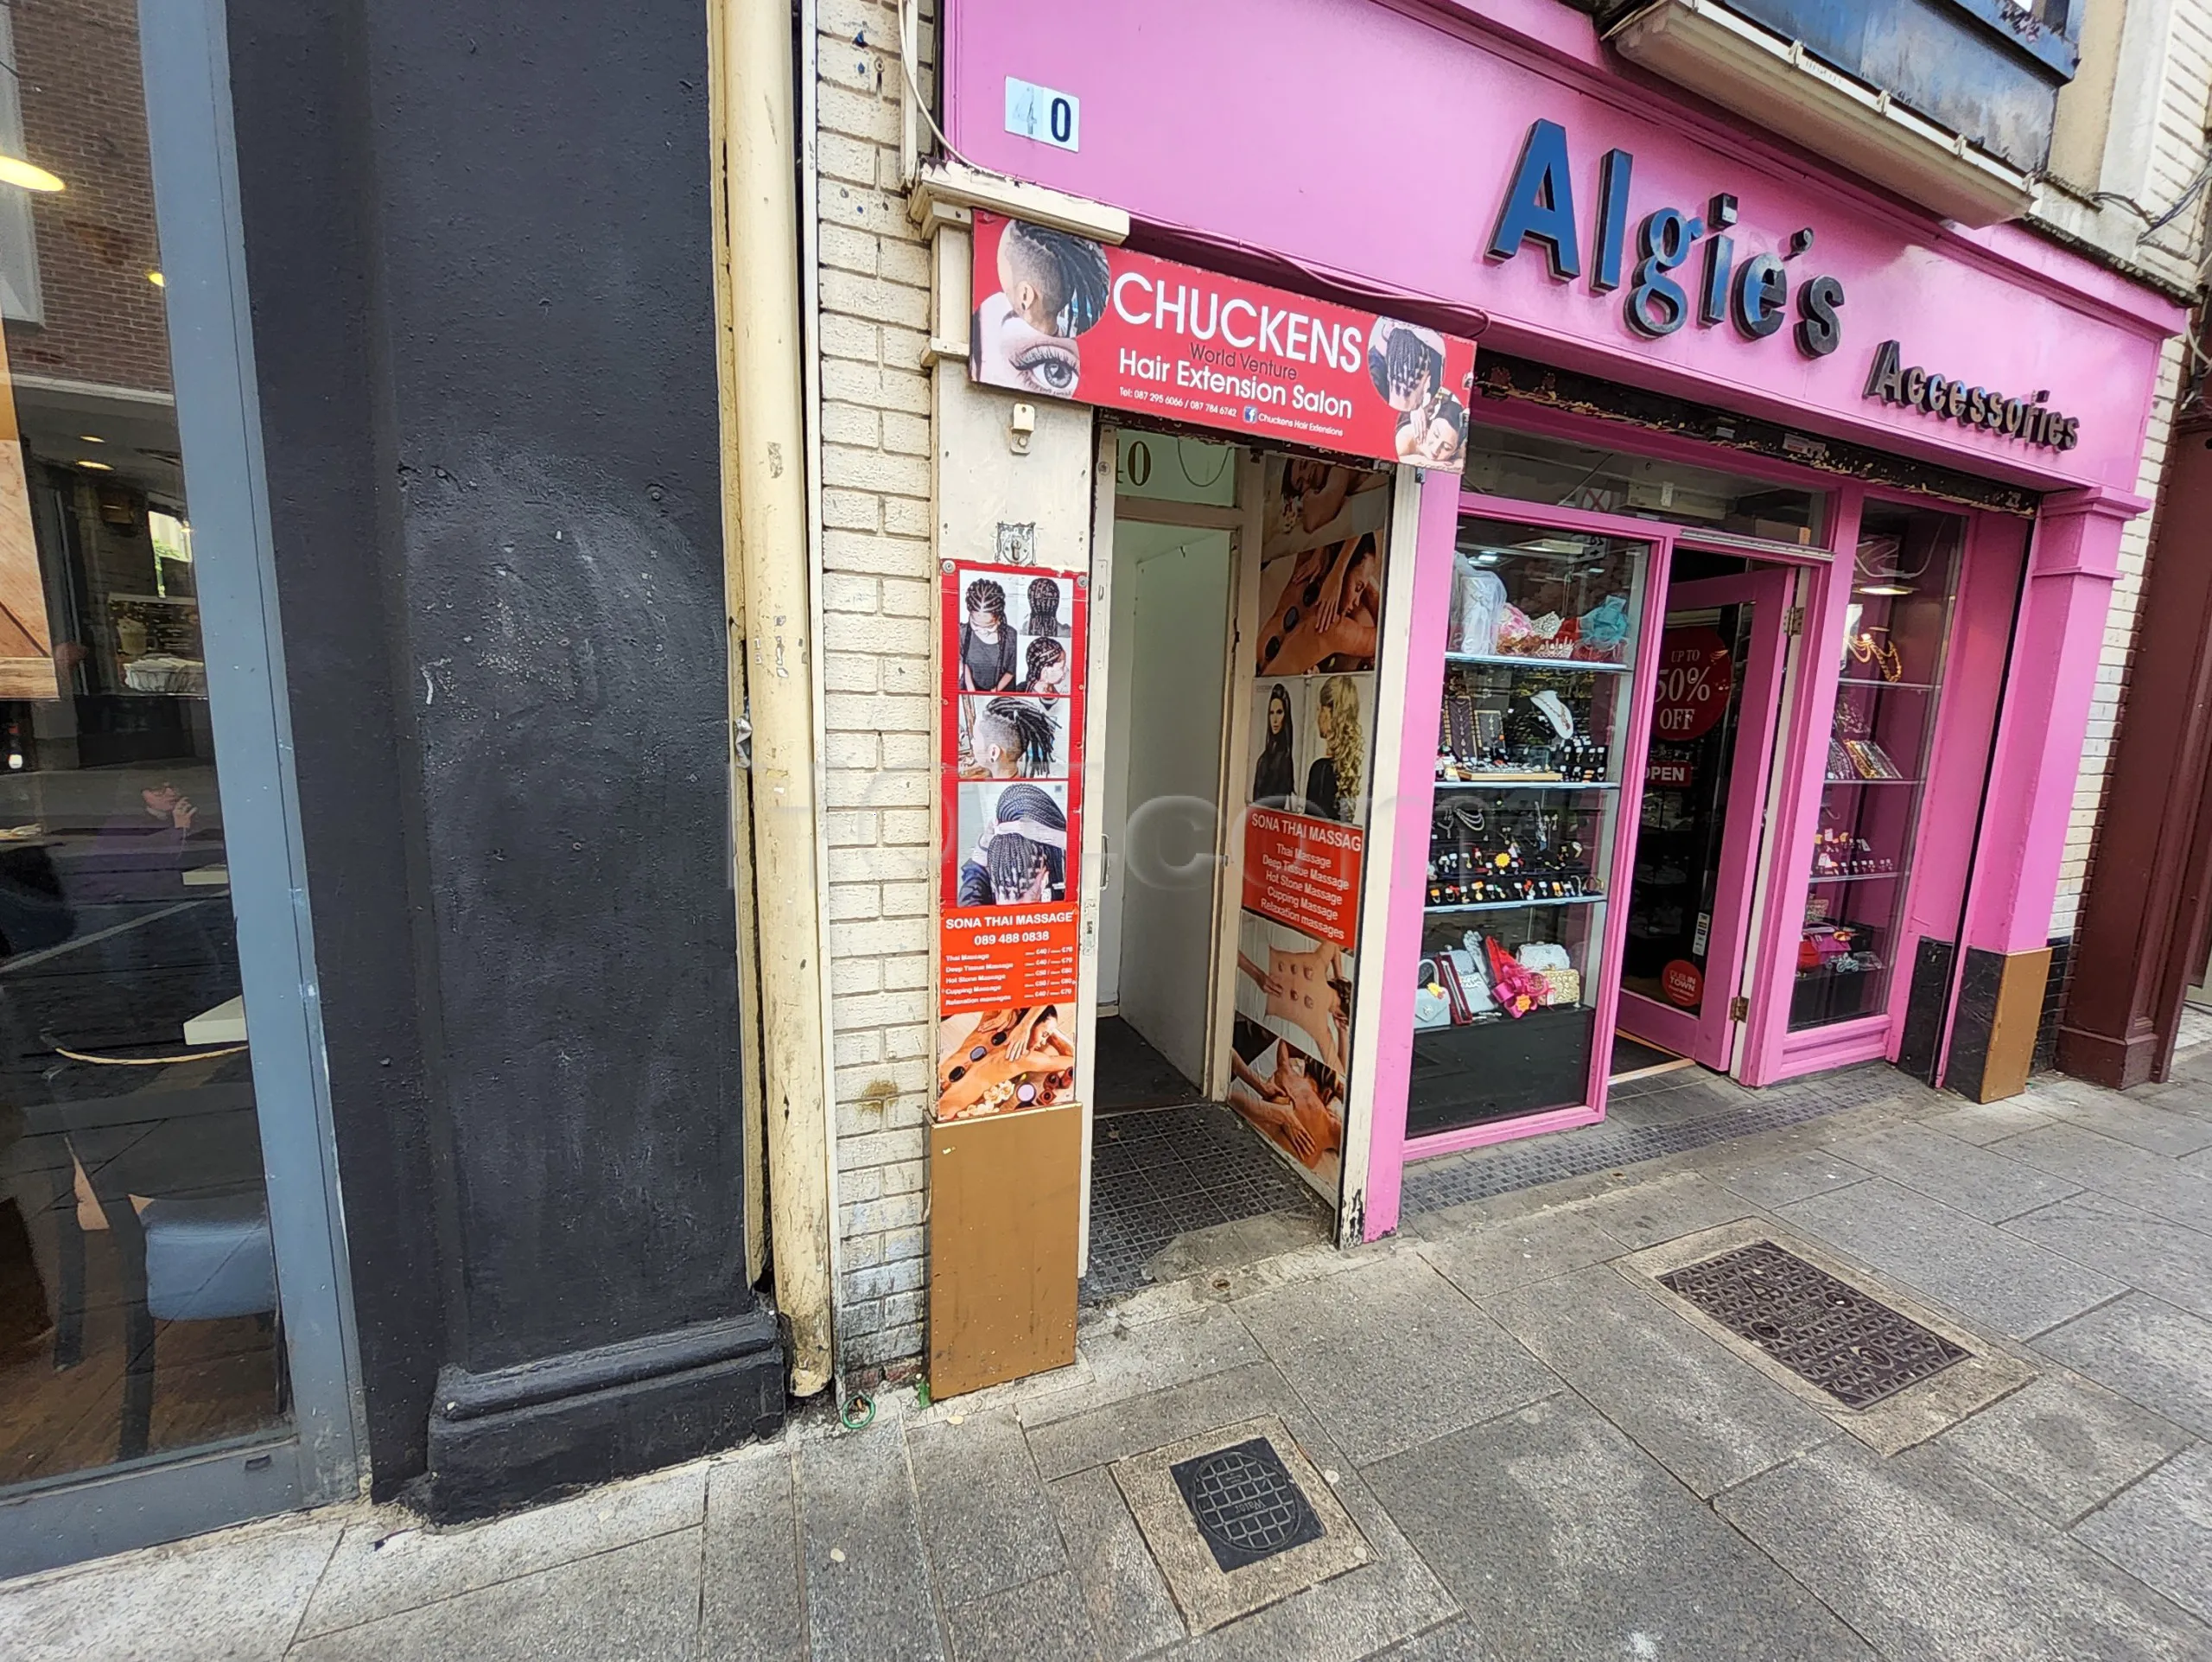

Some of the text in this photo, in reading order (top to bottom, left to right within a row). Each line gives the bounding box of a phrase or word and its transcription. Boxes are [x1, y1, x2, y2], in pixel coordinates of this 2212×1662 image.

[1485, 118, 1846, 359] Algie's
[1113, 271, 1362, 373] CHUCKENS
[1189, 341, 1297, 380] World Venture
[1119, 347, 1352, 419] Hair Extension Salon
[1863, 340, 2080, 452] Accessories
[1134, 390, 1148, 401] 087
[1149, 392, 1164, 404] 295
[1190, 400, 1204, 411] 087
[1219, 405, 1237, 417] 6742
[1258, 412, 1293, 428] Chuckens
[1294, 419, 1308, 430] Hair
[1309, 421, 1344, 436] Extensions
[1671, 649, 1700, 663] UP TO
[1656, 666, 1711, 703] 50%
[1659, 708, 1695, 730] OFF
[1251, 813, 1280, 831] SONA
[1281, 819, 1306, 838] THAI
[1262, 854, 1349, 891] Deep Tissue Massage
[1276, 843, 1332, 869] Thai Massage
[1266, 870, 1342, 906] Hot Stone Massage
[1267, 886, 1338, 921] Cupping Massage
[945, 912, 1073, 929] SONA THAI MASSAGE
[1261, 898, 1344, 939] Relaxation massages
[974, 931, 1050, 946] 089 488 0838
